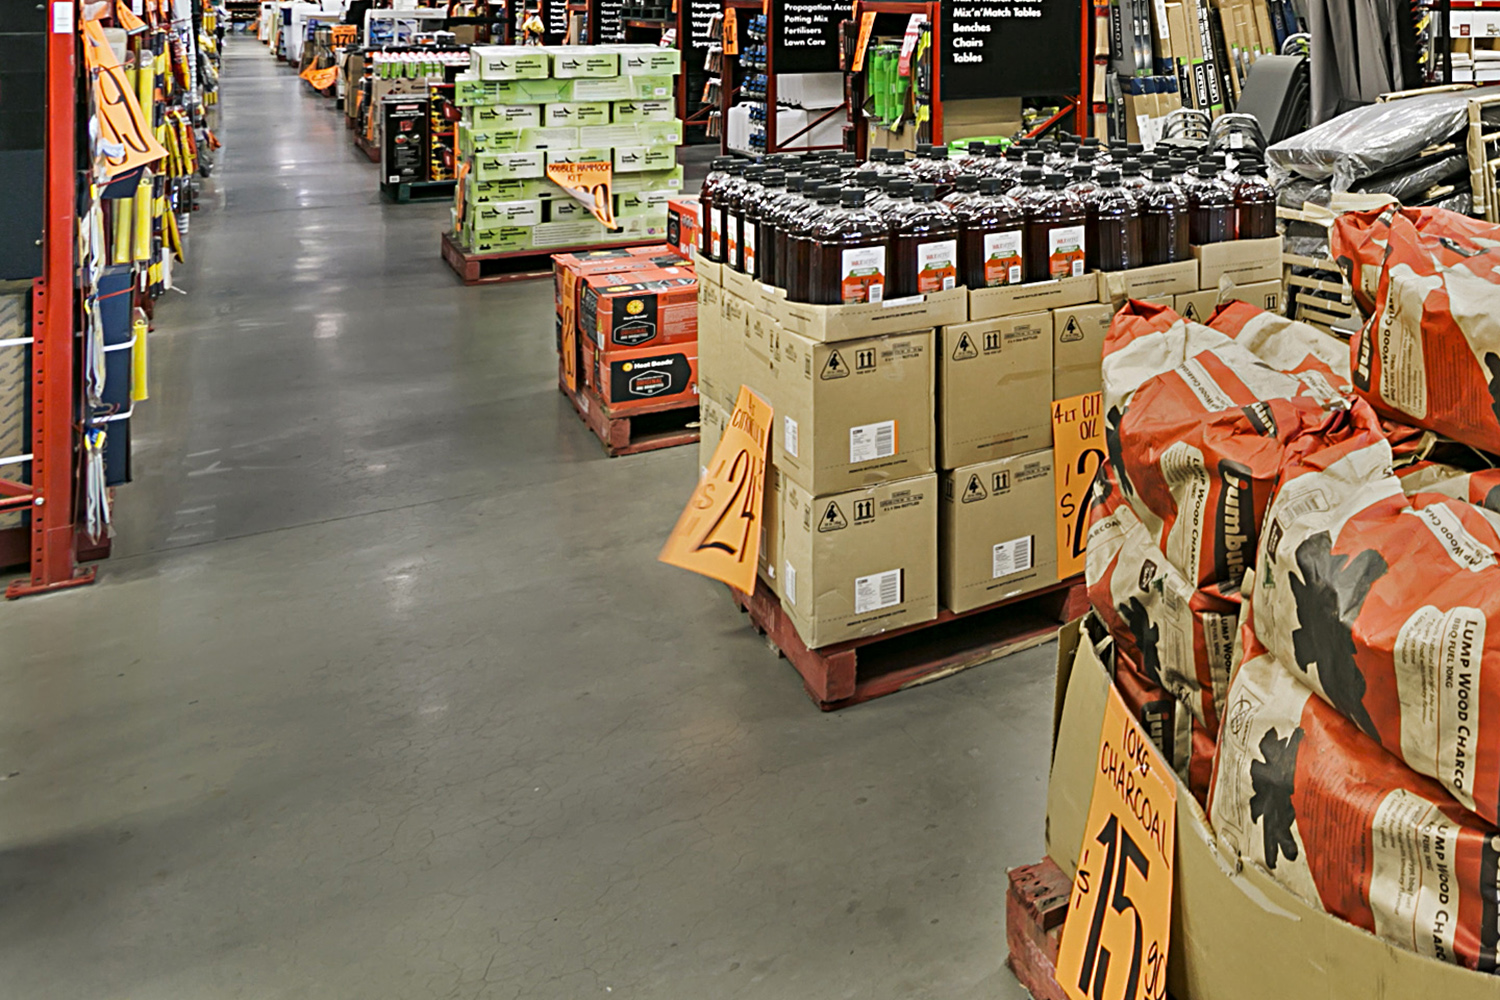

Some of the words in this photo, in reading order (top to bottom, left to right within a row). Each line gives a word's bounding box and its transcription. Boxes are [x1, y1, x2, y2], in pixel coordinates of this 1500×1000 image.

[692, 2, 721, 10] Hanging
[784, 3, 832, 13] Propagation
[953, 7, 1011, 18] Mix'n'Match
[1013, 7, 1041, 18] Tables
[784, 15, 811, 25] Potting
[813, 15, 828, 23] Mix
[784, 27, 822, 35] Fertilisers
[953, 22, 991, 33] Benches
[953, 37, 983, 48] Chairs
[953, 52, 983, 63] Tables
[567, 173, 583, 182] KIT
[1382, 329, 1391, 364] WOOD
[1079, 420, 1099, 440] OIL
[1192, 487, 1206, 526] WOOD
[1441, 524, 1463, 557] WOOD
[1221, 618, 1230, 641] UMP
[1448, 617, 1461, 638] BBQ
[1447, 640, 1457, 664] FUEL
[1458, 619, 1478, 668] LUMP
[1445, 665, 1454, 689] 10KG
[1457, 672, 1472, 722] WOOD
[1453, 725, 1471, 790] CHARCO
[1101, 741, 1169, 870] CHARCOAL
[1432, 824, 1449, 866] UMP
[1436, 864, 1450, 905] WOOD
